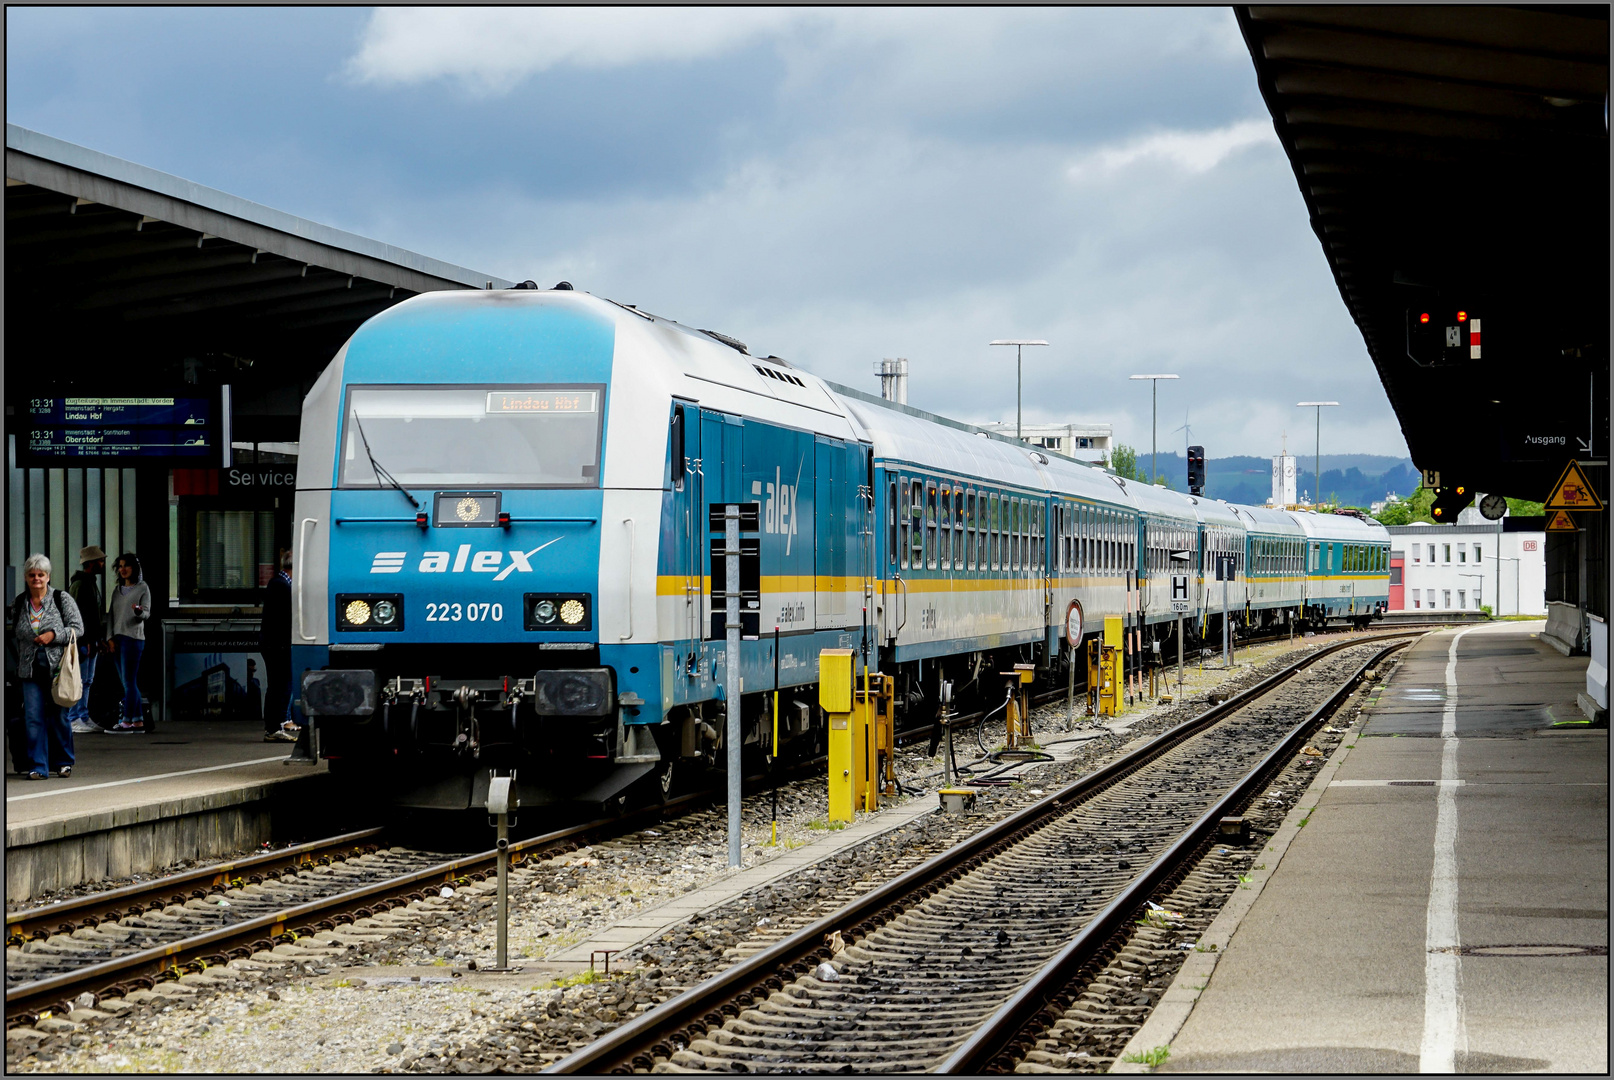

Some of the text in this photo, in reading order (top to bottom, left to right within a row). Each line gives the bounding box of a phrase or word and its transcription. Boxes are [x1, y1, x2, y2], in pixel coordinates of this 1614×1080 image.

[30, 398, 54, 408] 13:31
[502, 397, 580, 410] Lindau Hbf
[65, 412, 103, 420] Lindau Hbf
[30, 430, 54, 439] 13:31
[65, 436, 104, 444] Oberstdorf
[1524, 434, 1566, 446] Ausgang
[229, 469, 294, 486] Service
[765, 451, 806, 556] alex
[1525, 542, 1536, 550] DB
[418, 536, 565, 581] alex
[1173, 576, 1187, 599] H
[426, 603, 503, 622] 223 070
[1173, 603, 1188, 611] 160m
